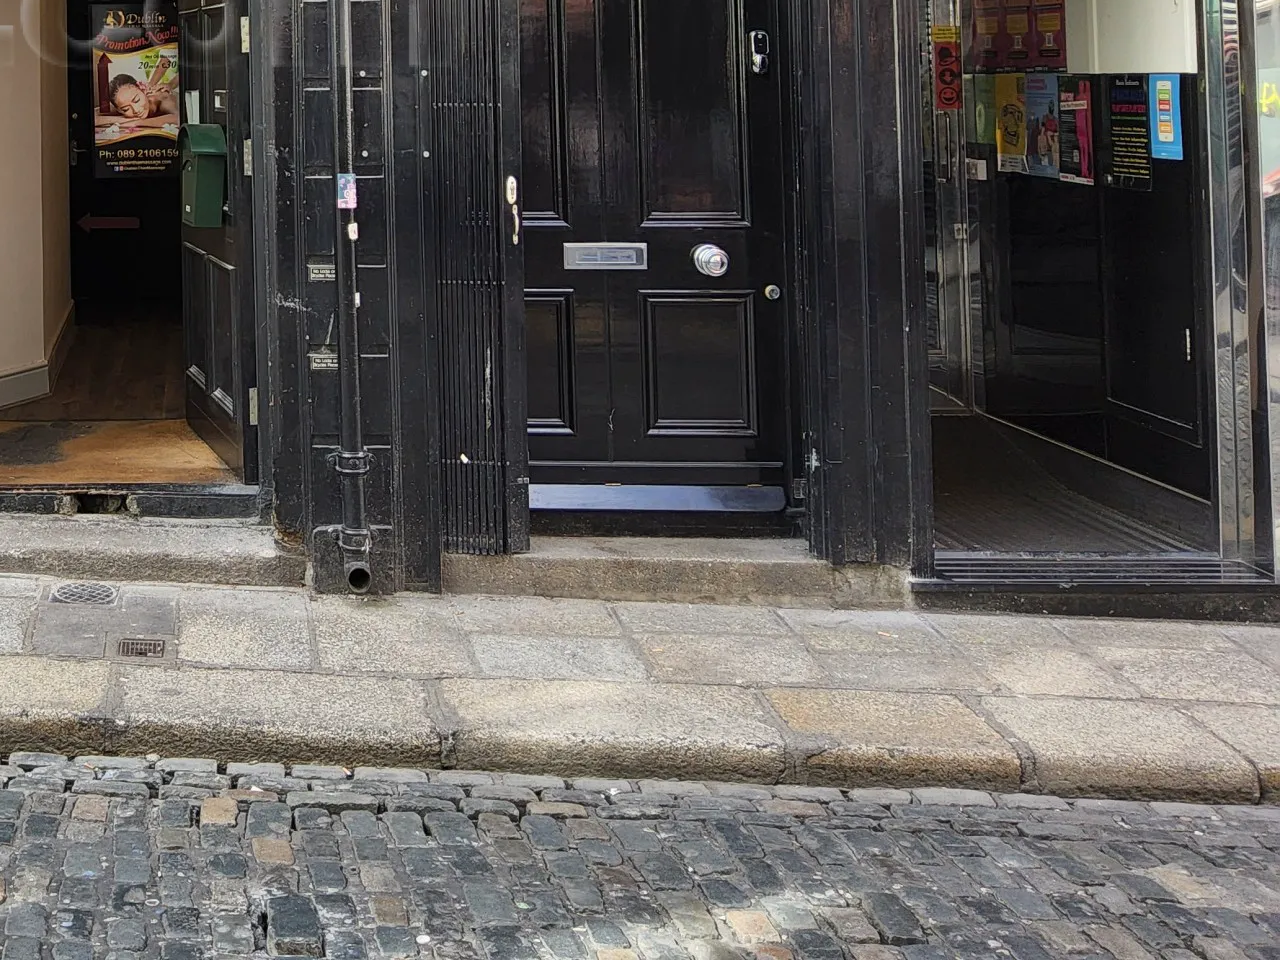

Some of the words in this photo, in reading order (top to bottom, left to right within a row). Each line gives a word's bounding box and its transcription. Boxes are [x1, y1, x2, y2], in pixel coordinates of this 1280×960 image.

[126, 11, 168, 24] Dublin
[96, 34, 146, 50] Promotion
[99, 150, 115, 159] Ph:
[117, 149, 135, 158] 089
[138, 148, 178, 158] 2106159
